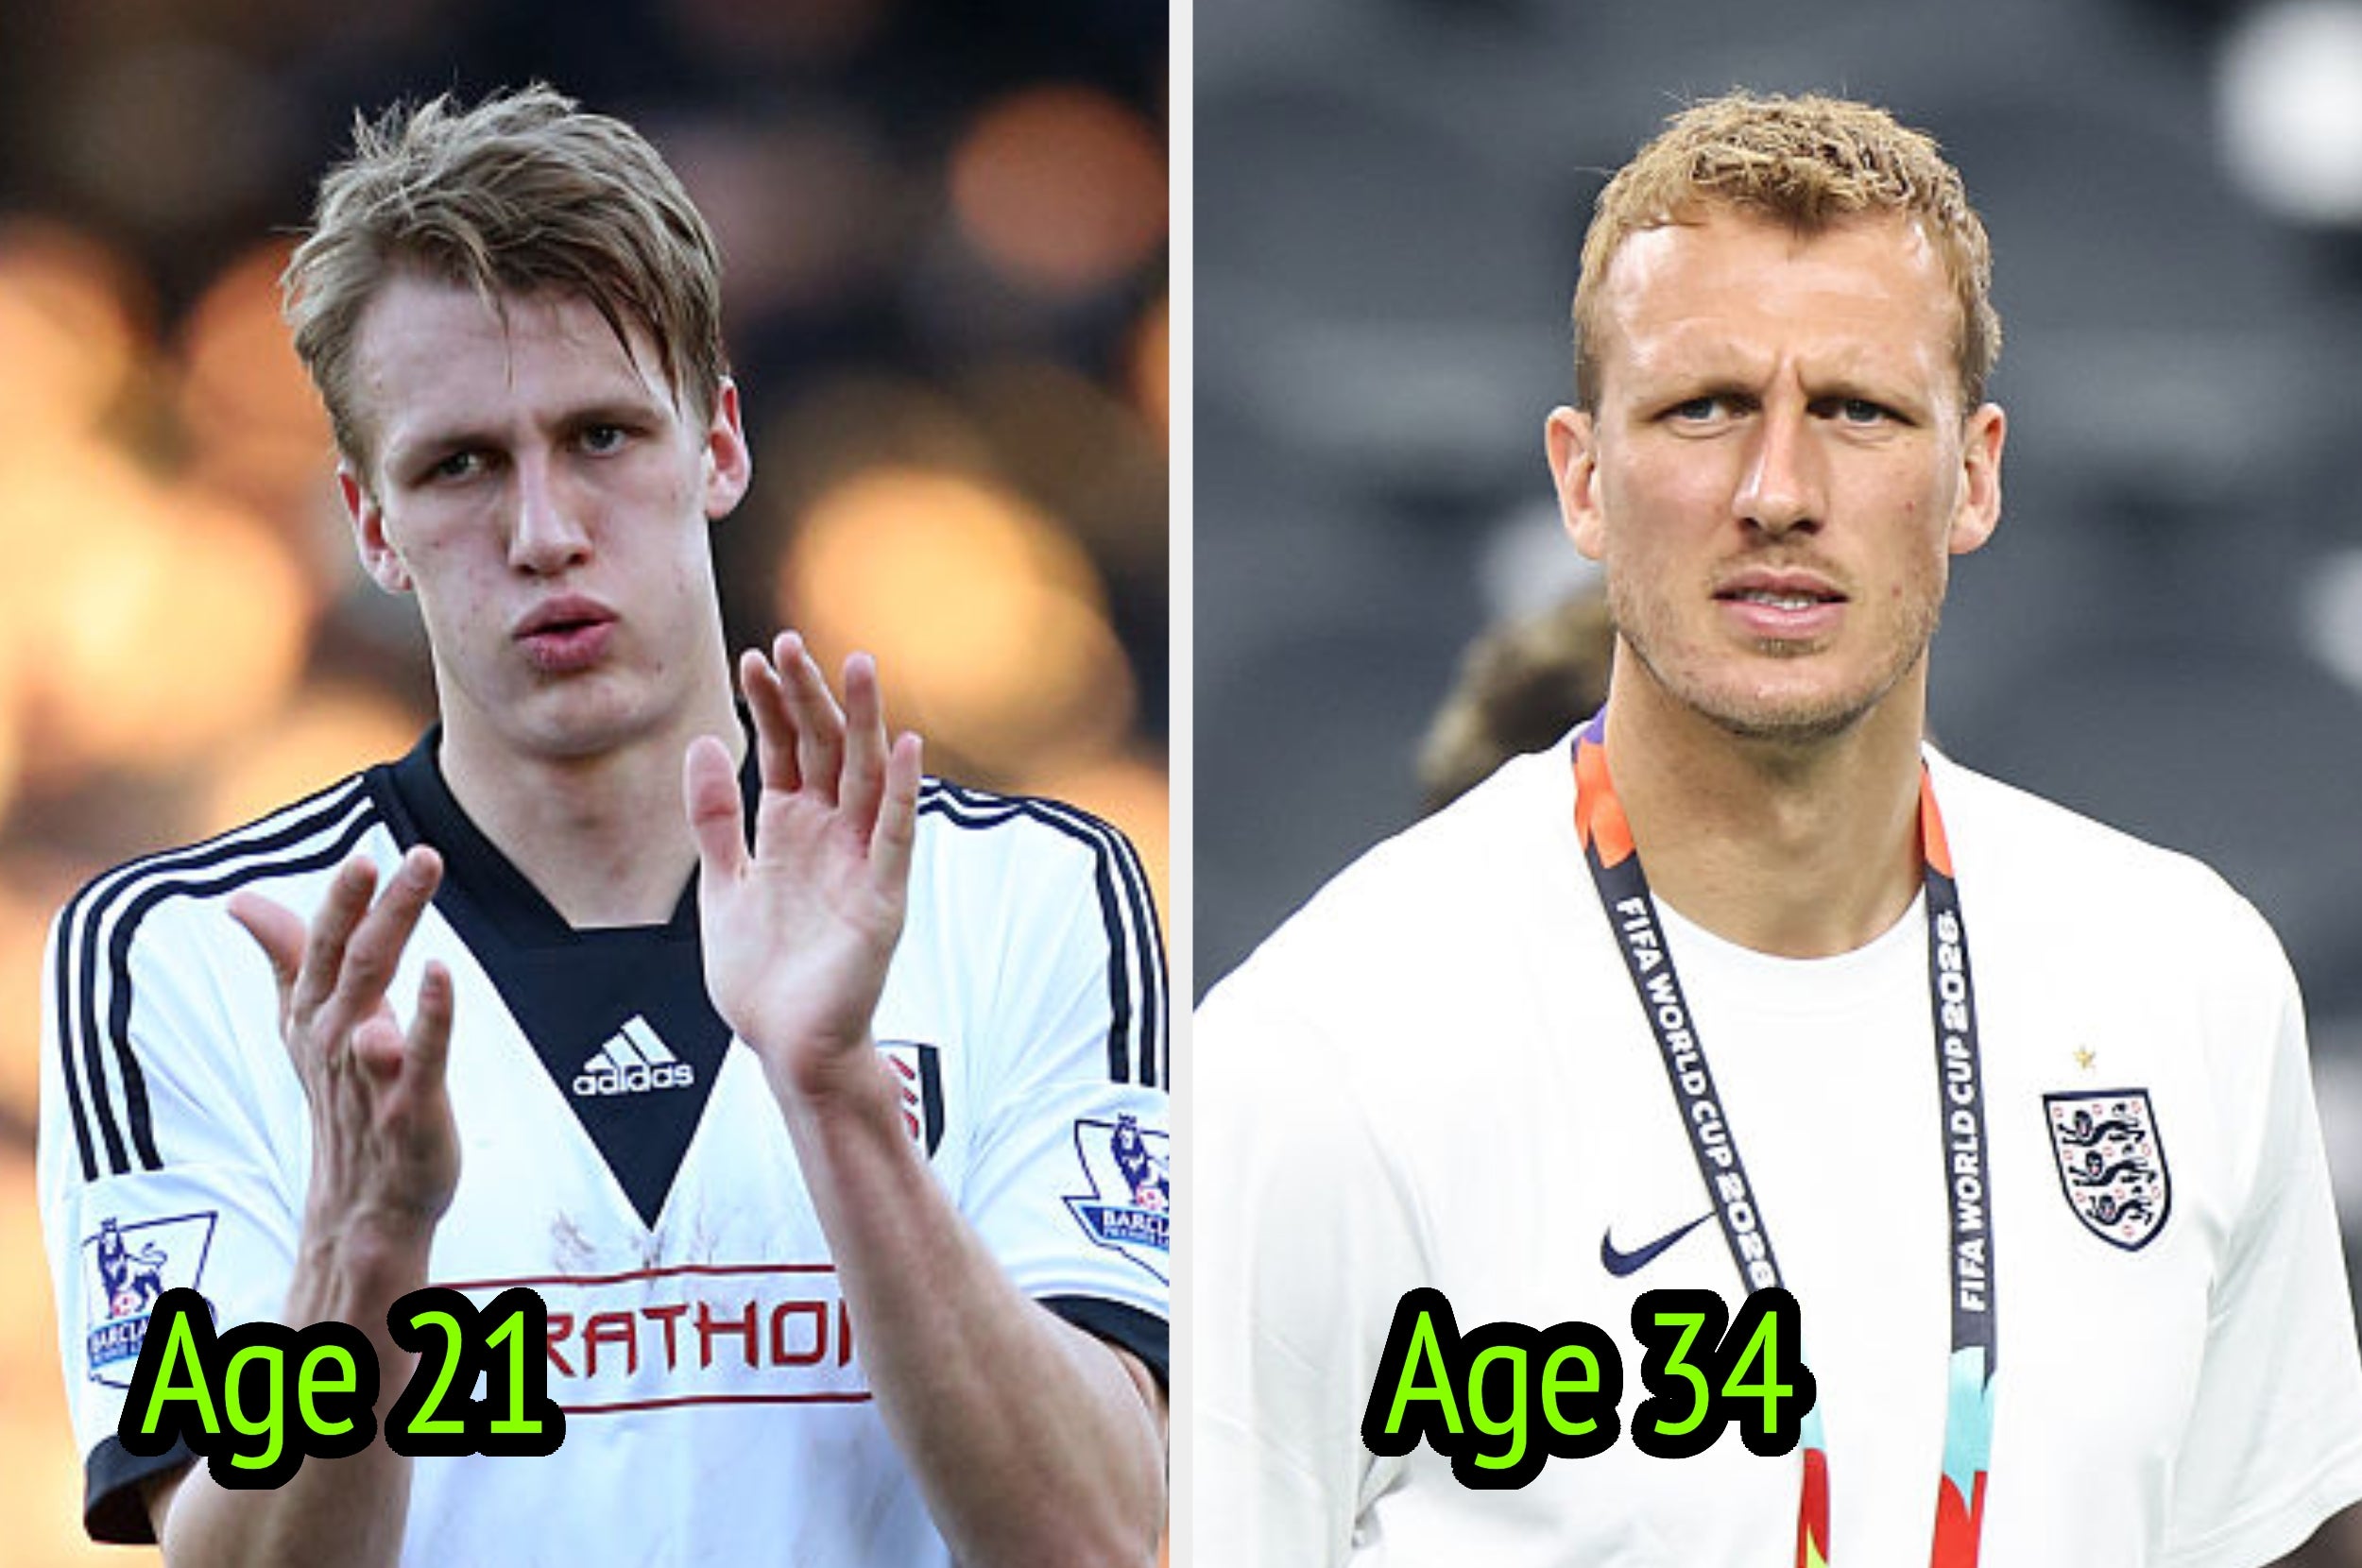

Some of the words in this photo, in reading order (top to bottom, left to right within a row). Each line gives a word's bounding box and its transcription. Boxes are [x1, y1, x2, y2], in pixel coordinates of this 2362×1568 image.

[1938, 912, 1968, 1032] 2026
[573, 1064, 694, 1096] adidas
[1616, 895, 1663, 973] FIFA
[1646, 973, 1706, 1096] WORLD
[1692, 1100, 1735, 1169] CUP
[1943, 1036, 1974, 1106] CUP
[1954, 1111, 1984, 1232] WORLD
[1960, 1237, 1986, 1313] FIFA
